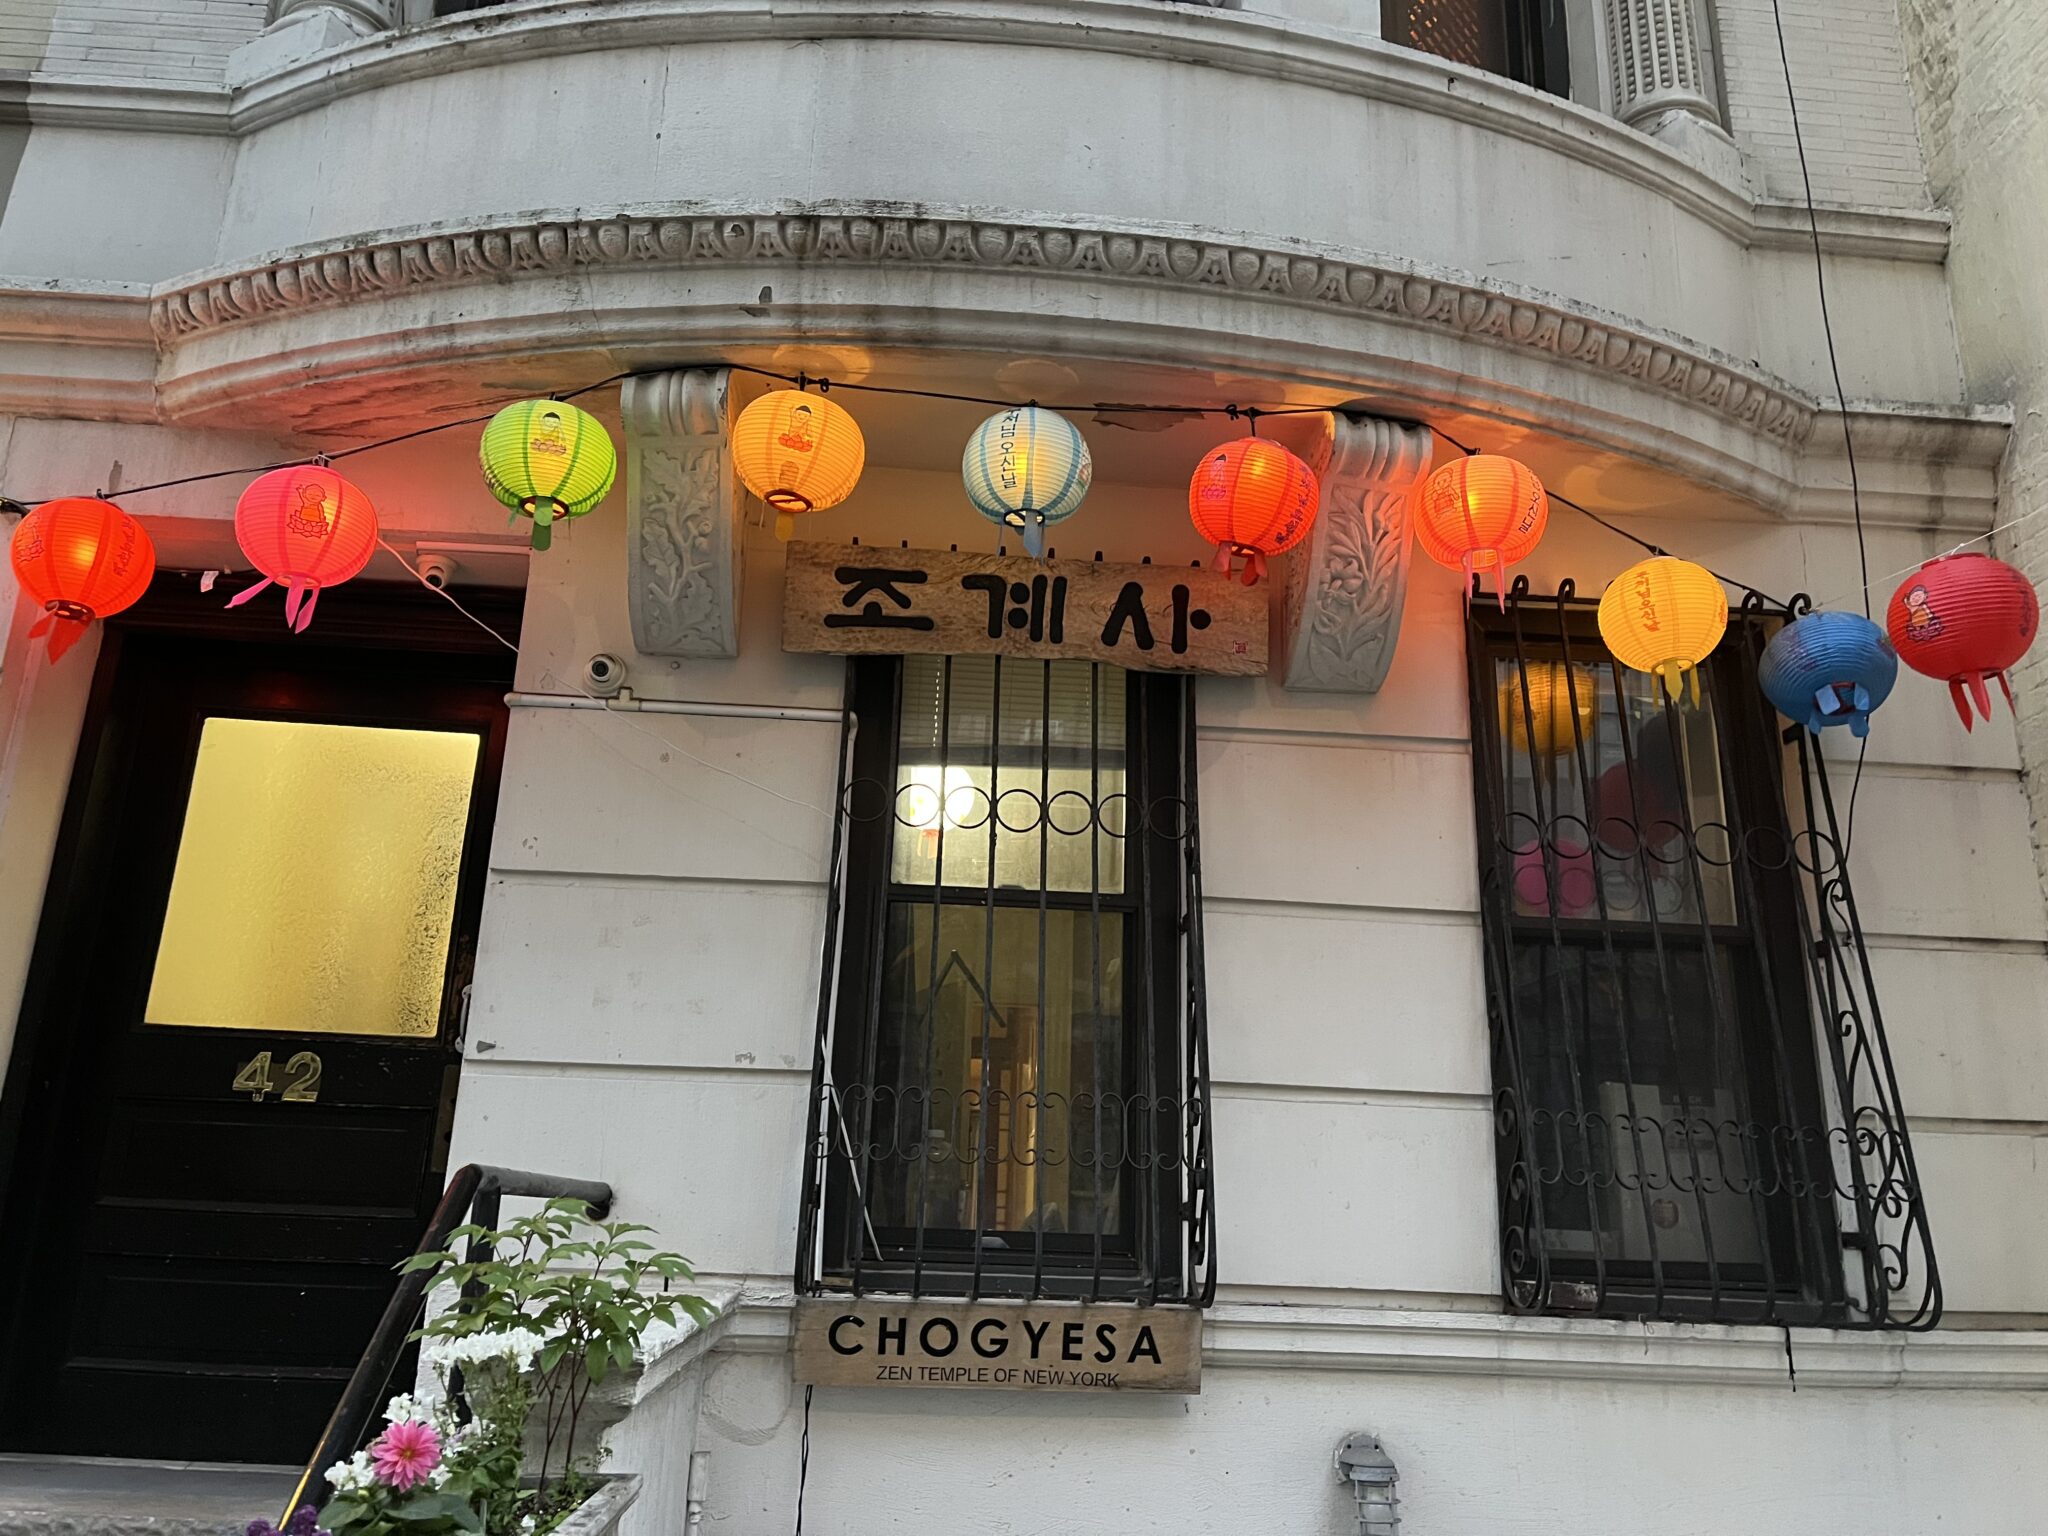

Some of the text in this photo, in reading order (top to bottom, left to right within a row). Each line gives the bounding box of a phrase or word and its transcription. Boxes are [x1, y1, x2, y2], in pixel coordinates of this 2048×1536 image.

[1000, 441, 1018, 489] 오신날
[823, 566, 1212, 655] 조계사
[232, 1051, 322, 1102] 42
[828, 1314, 1162, 1364] CHOGYESA
[876, 1366, 1120, 1388] ZEN TEMPLE OF NEW YORK
